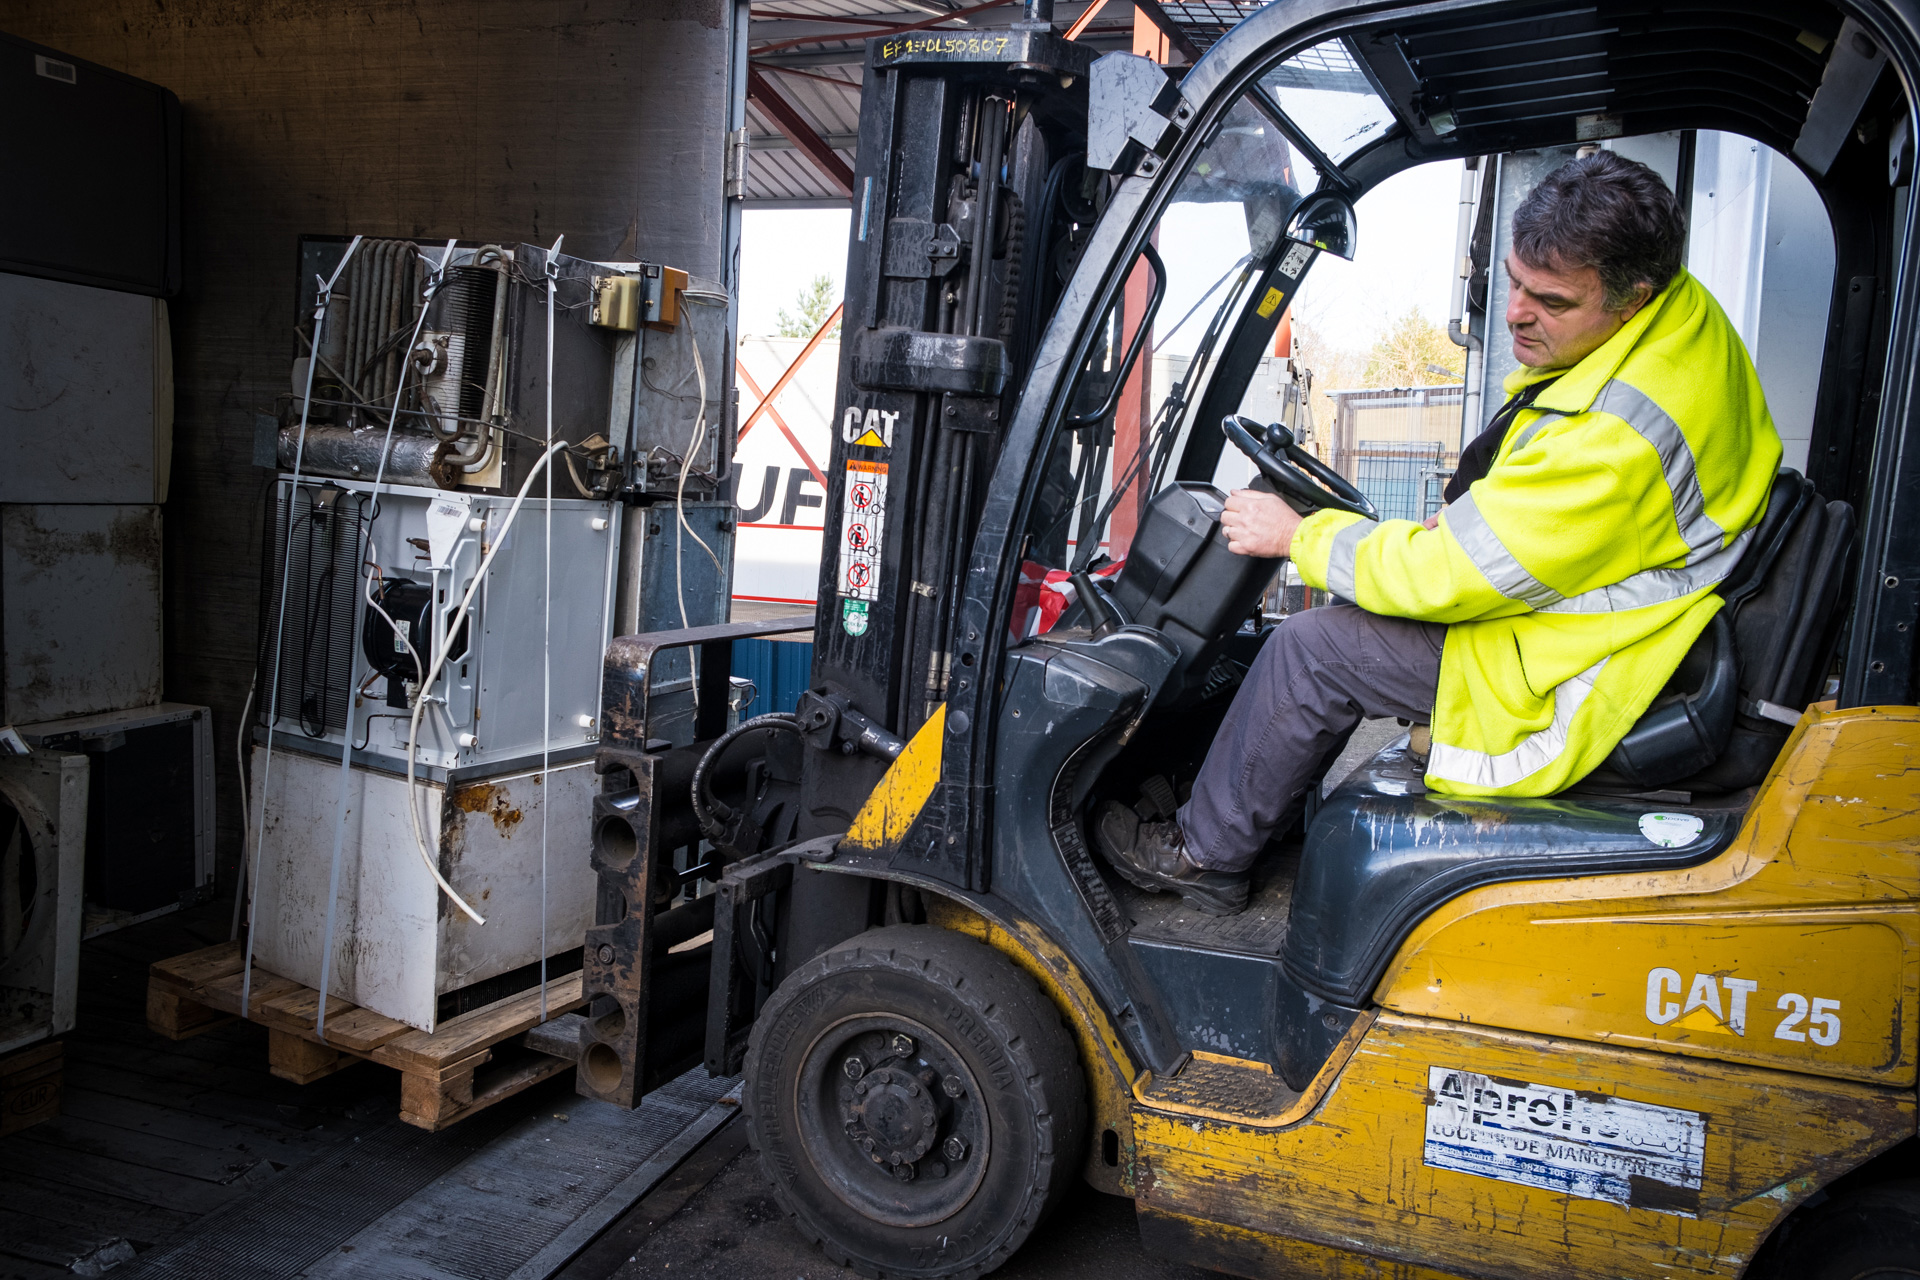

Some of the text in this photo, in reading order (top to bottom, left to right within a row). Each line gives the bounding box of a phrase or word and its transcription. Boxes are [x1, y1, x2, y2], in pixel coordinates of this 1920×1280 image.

[843, 406, 900, 448] CAT
[858, 464, 887, 473] WARNING
[1645, 967, 1841, 1047] CAT 25
[944, 983, 1014, 1090] PREMIA
[21, 1086, 48, 1111] EUR
[759, 1010, 803, 1148] TRELLEBORG
[1432, 1123, 1509, 1149] LOUER
[1513, 1134, 1540, 1155] DE
